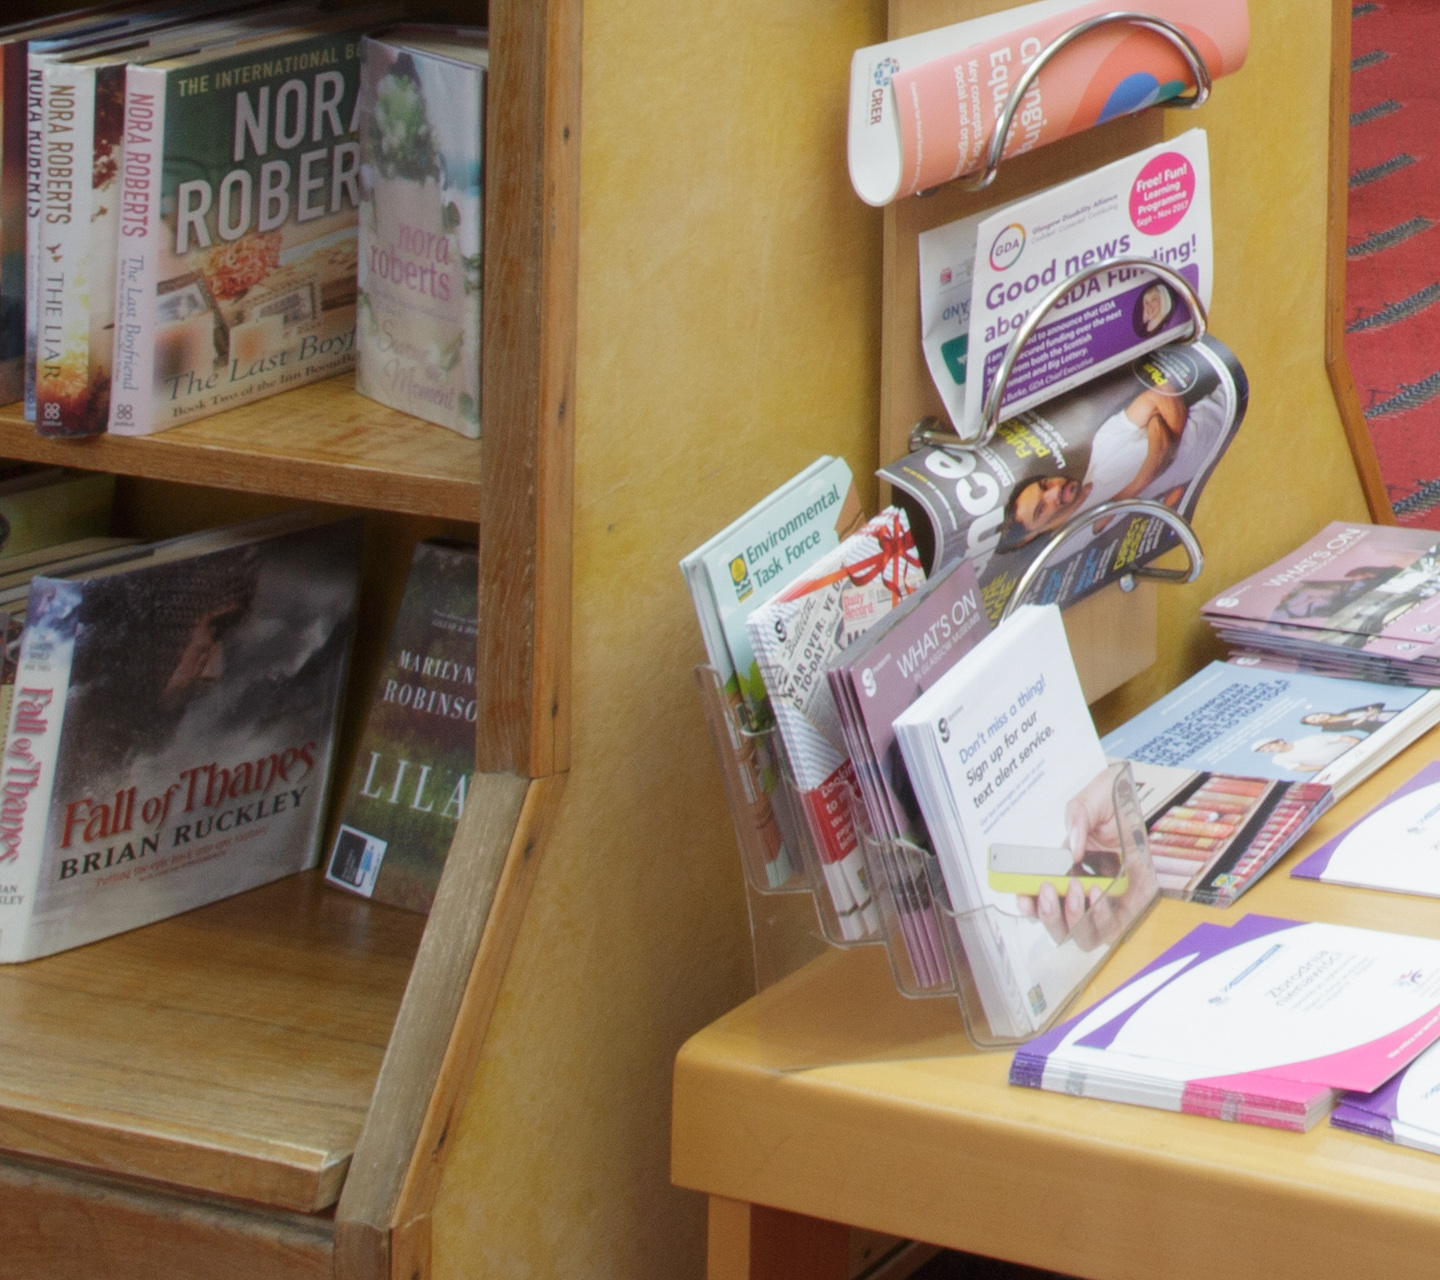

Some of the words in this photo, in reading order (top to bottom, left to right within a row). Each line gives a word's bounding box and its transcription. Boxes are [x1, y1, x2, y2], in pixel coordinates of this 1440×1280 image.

[179, 75, 209, 97] THE
[215, 53, 335, 91] INTERNATIONAL
[49, 84, 75, 134] NORA
[128, 92, 154, 145] NORA
[869, 88, 883, 126] CRER
[46, 142, 73, 225] ROBERTS
[122, 151, 151, 238] ROBERTS
[1137, 171, 1162, 193] Free!
[1164, 163, 1187, 181] Fun!
[1138, 190, 1187, 215] Programme
[1143, 182, 1180, 201] Learning
[1136, 216, 1153, 229] Sept
[1157, 208, 1172, 220] Nov
[1173, 200, 1189, 213] 2017
[369, 245, 452, 302] roberts
[985, 258, 1057, 310] Good
[1064, 234, 1131, 280] news
[995, 239, 1020, 257] GDA
[45, 273, 64, 317] THE
[43, 321, 62, 379] LIAR
[164, 366, 219, 403] The
[229, 348, 287, 384] Last
[745, 484, 841, 566] Environmental
[753, 562, 784, 589] Task
[784, 530, 821, 566] Force
[897, 616, 951, 680] WHAT'S
[951, 589, 978, 626] ON
[959, 732, 987, 765] Don't
[987, 712, 1009, 738] miss
[1009, 704, 1018, 716] a
[1017, 673, 1046, 708] thing!
[966, 760, 989, 787] Sign
[989, 745, 1004, 764] up
[1004, 728, 1018, 749] for
[1020, 710, 1038, 733] our
[973, 783, 994, 809] text
[994, 758, 1018, 787] alert
[1018, 725, 1055, 764] service.
[60, 784, 137, 849] Fall
[141, 782, 181, 825] of
[180, 741, 318, 815] Thanes
[359, 750, 470, 819] LILA
[59, 834, 161, 880] BRIAN
[173, 786, 310, 848] RUCKLEY
